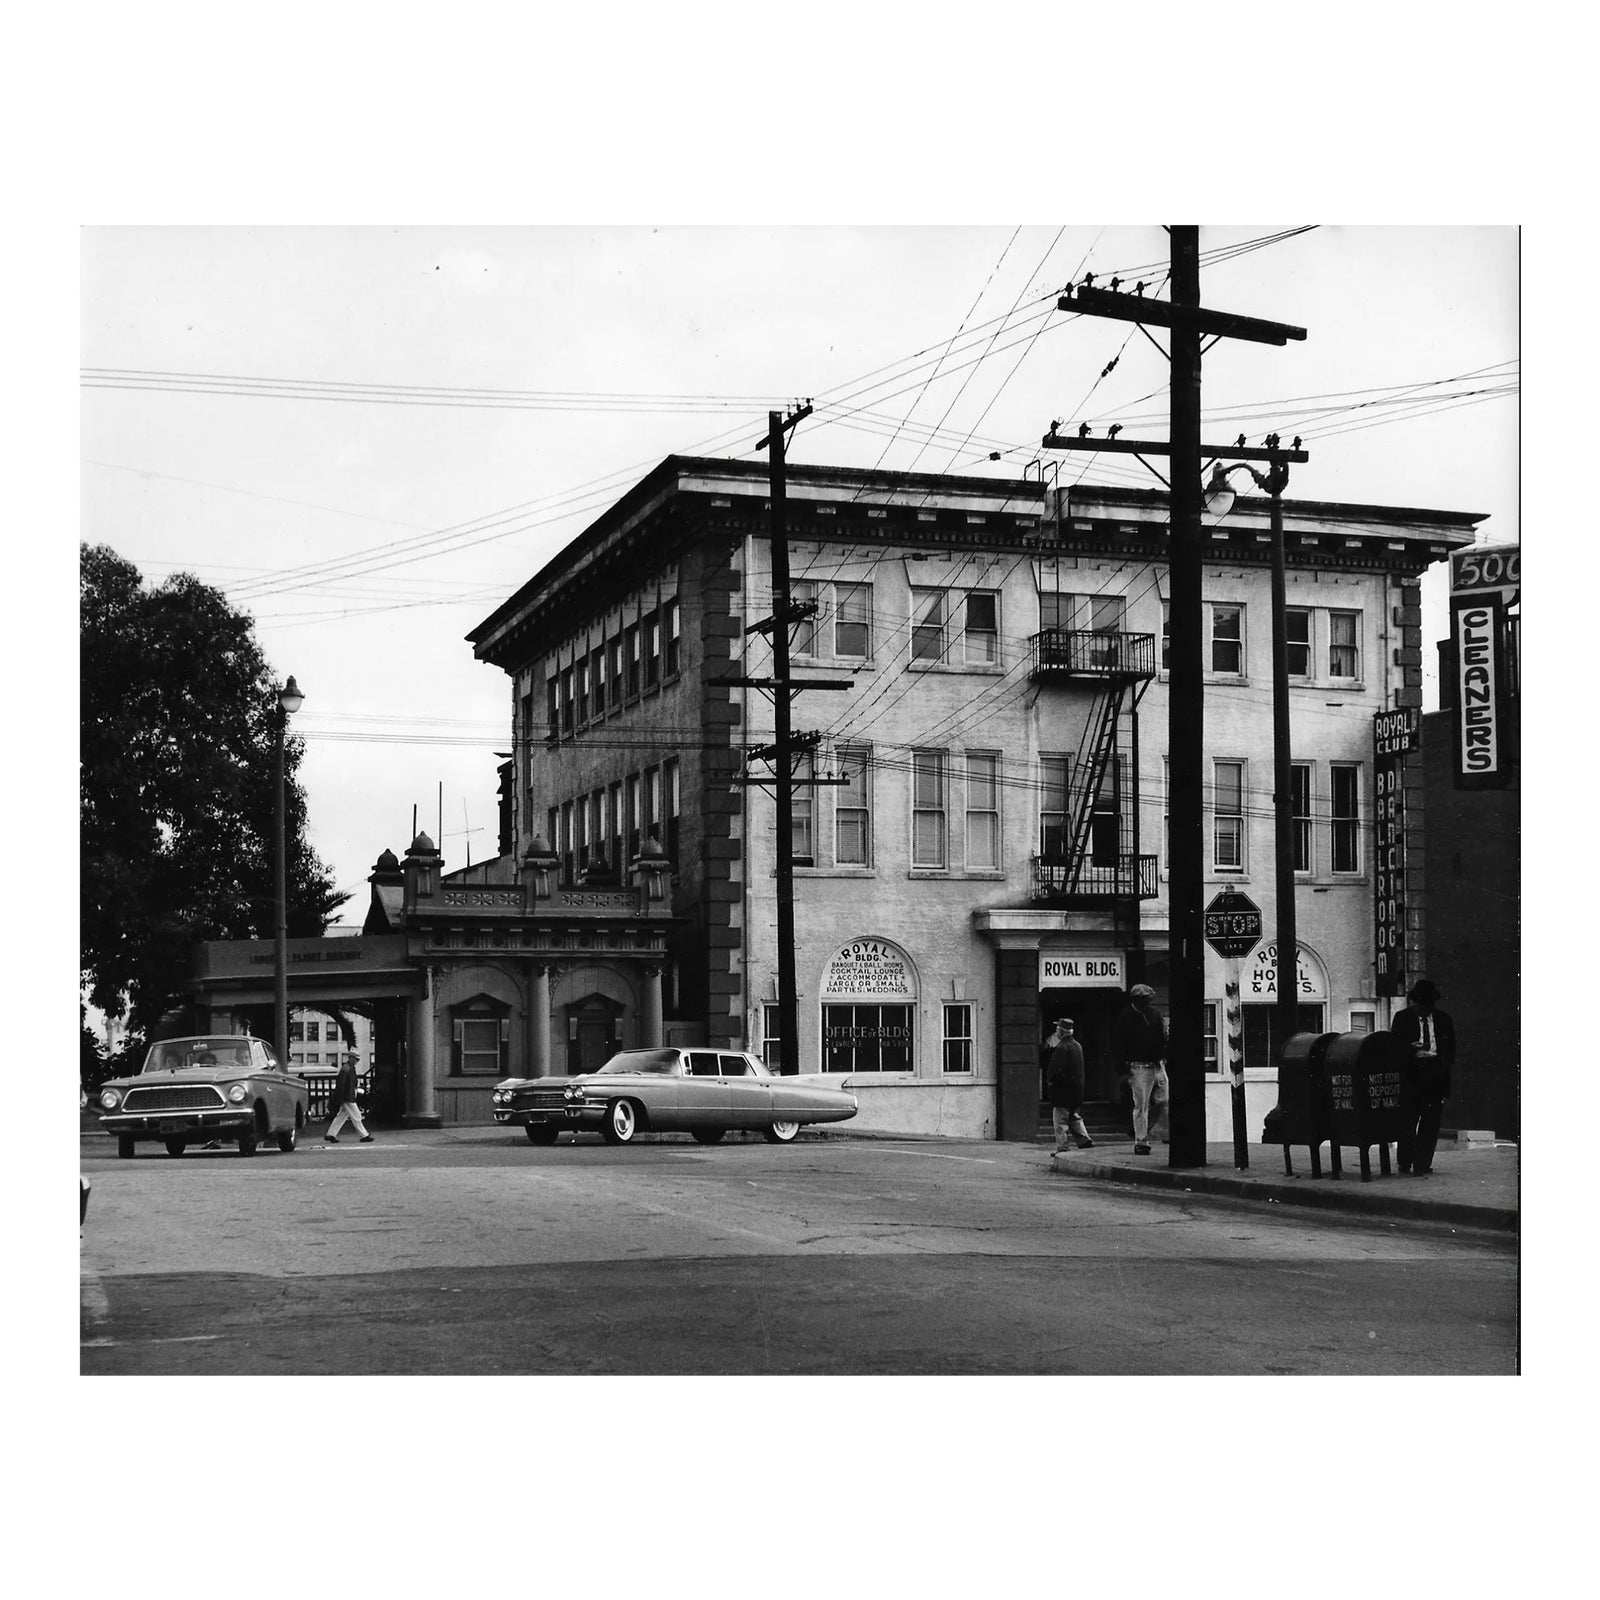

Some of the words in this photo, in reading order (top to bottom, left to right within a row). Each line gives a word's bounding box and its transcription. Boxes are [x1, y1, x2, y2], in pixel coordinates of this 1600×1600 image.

[1463, 610, 1492, 770] CLEANERS
[1376, 712, 1410, 739] ROYAL
[1377, 735, 1409, 754] CLUB
[1387, 770, 1396, 948] DANCING
[1377, 773, 1388, 974] BALLROOM
[1207, 915, 1258, 935] STOP
[841, 942, 889, 959] ROYAL
[1257, 946, 1301, 963] ROL
[1045, 961, 1082, 976] ROYAL
[1086, 961, 1119, 976] BLDG.
[1253, 970, 1309, 980] HOL
[1252, 982, 1262, 993] &
[1267, 982, 1316, 993] AS.
[825, 1026, 868, 1038] OFFICE
[878, 1026, 911, 1038] BLDG
[1368, 1073, 1383, 1084] NOT
[1384, 1072, 1400, 1083] FOR
[1369, 1084, 1400, 1097] DEPOSIT
[1371, 1097, 1381, 1109] OF
